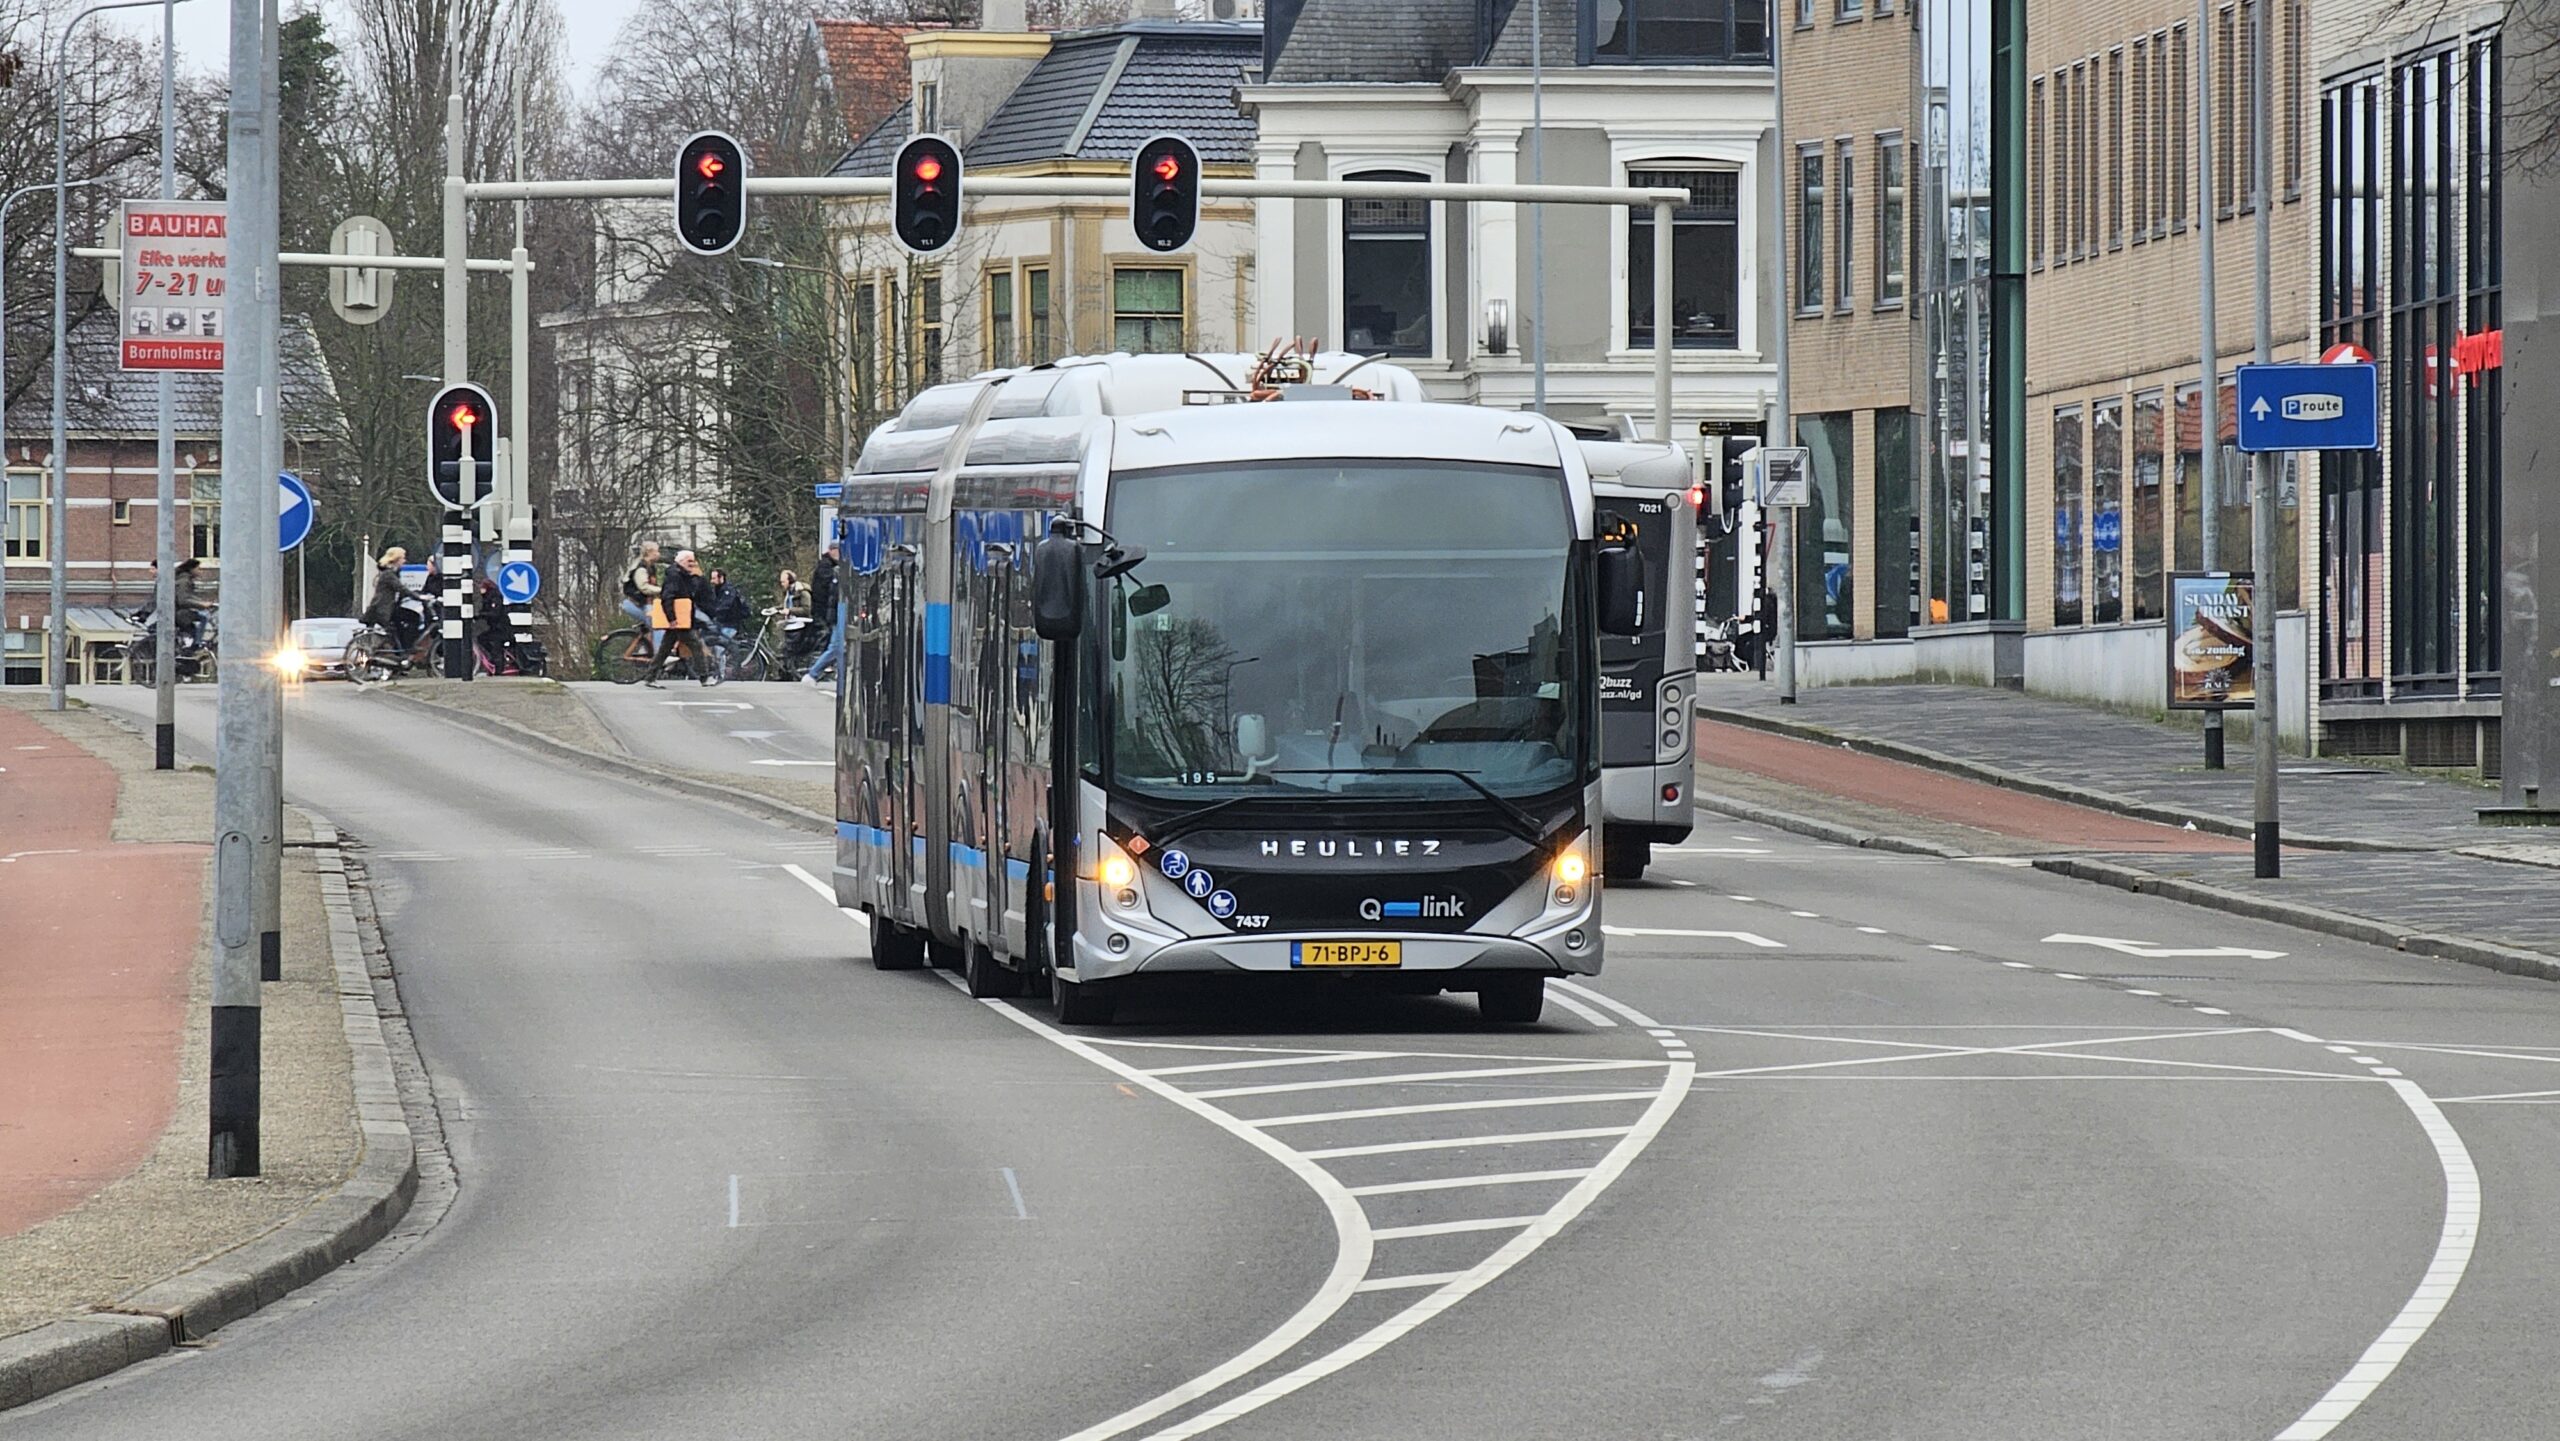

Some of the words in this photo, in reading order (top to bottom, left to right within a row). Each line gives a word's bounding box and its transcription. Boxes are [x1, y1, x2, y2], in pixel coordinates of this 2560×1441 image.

[130, 216, 227, 235] BAUHA
[139, 250, 175, 267] Elke
[205, 277, 226, 296] u
[129, 345, 222, 361] Bornholmstra
[2302, 400, 2340, 412] route
[1638, 503, 1662, 514] 7021
[2184, 593, 2239, 607] SUNDAY
[1600, 675, 1633, 690] Qbuzz
[1260, 840, 1441, 857] HEULIEZ
[1359, 898, 1382, 921] Q
[1423, 895, 1465, 918] link
[1235, 915, 1270, 928] 7437
[1311, 945, 1390, 962] 71-BPJ-6
